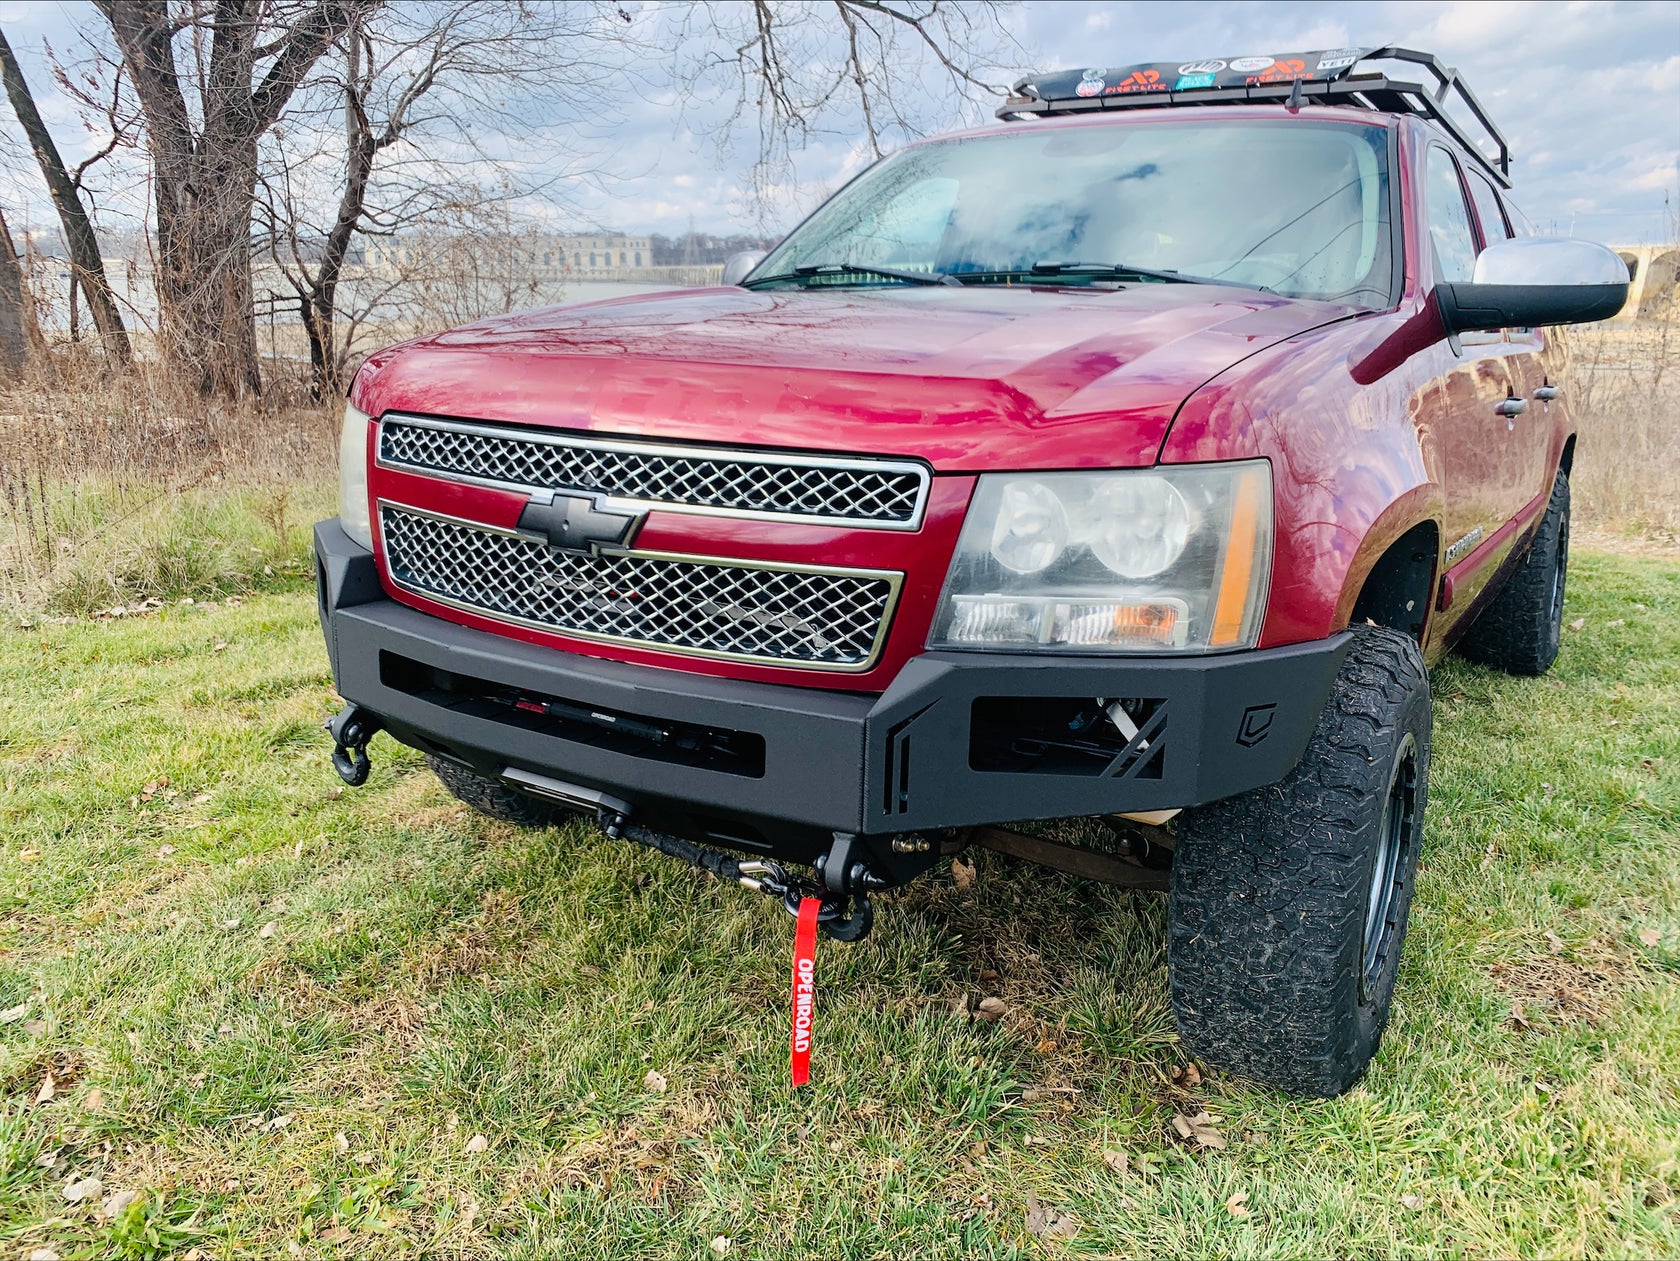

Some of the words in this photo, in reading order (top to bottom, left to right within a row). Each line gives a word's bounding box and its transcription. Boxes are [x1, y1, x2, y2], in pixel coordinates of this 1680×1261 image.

[1321, 57, 1354, 67] YETI
[1245, 74, 1282, 84] FIRST
[1283, 73, 1314, 82] LITE
[1105, 85, 1140, 94] FIRST
[1141, 83, 1167, 92] LITE
[795, 958, 815, 1053] OPENROAD
